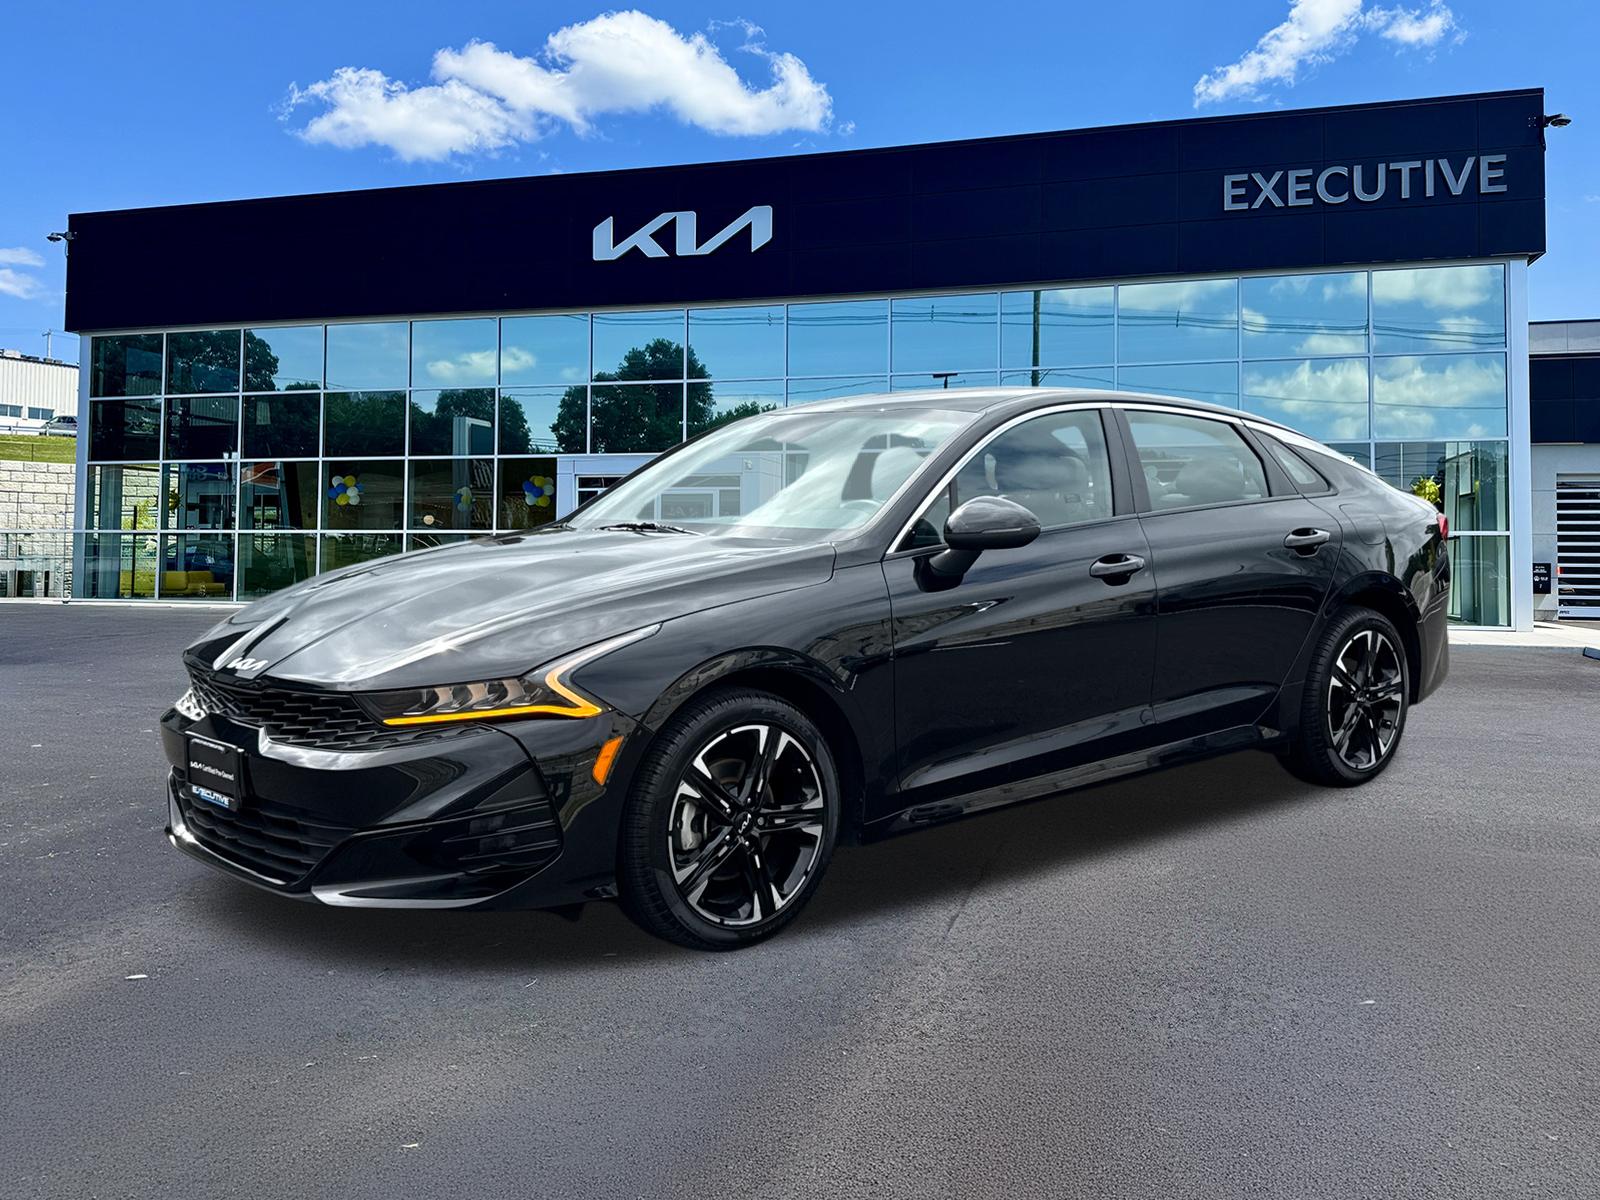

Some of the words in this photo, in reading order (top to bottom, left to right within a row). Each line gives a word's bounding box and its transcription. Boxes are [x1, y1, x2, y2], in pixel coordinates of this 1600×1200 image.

[1223, 154, 1508, 211] EXECUTIVE
[592, 205, 773, 261] KIA
[226, 657, 269, 671] KIA
